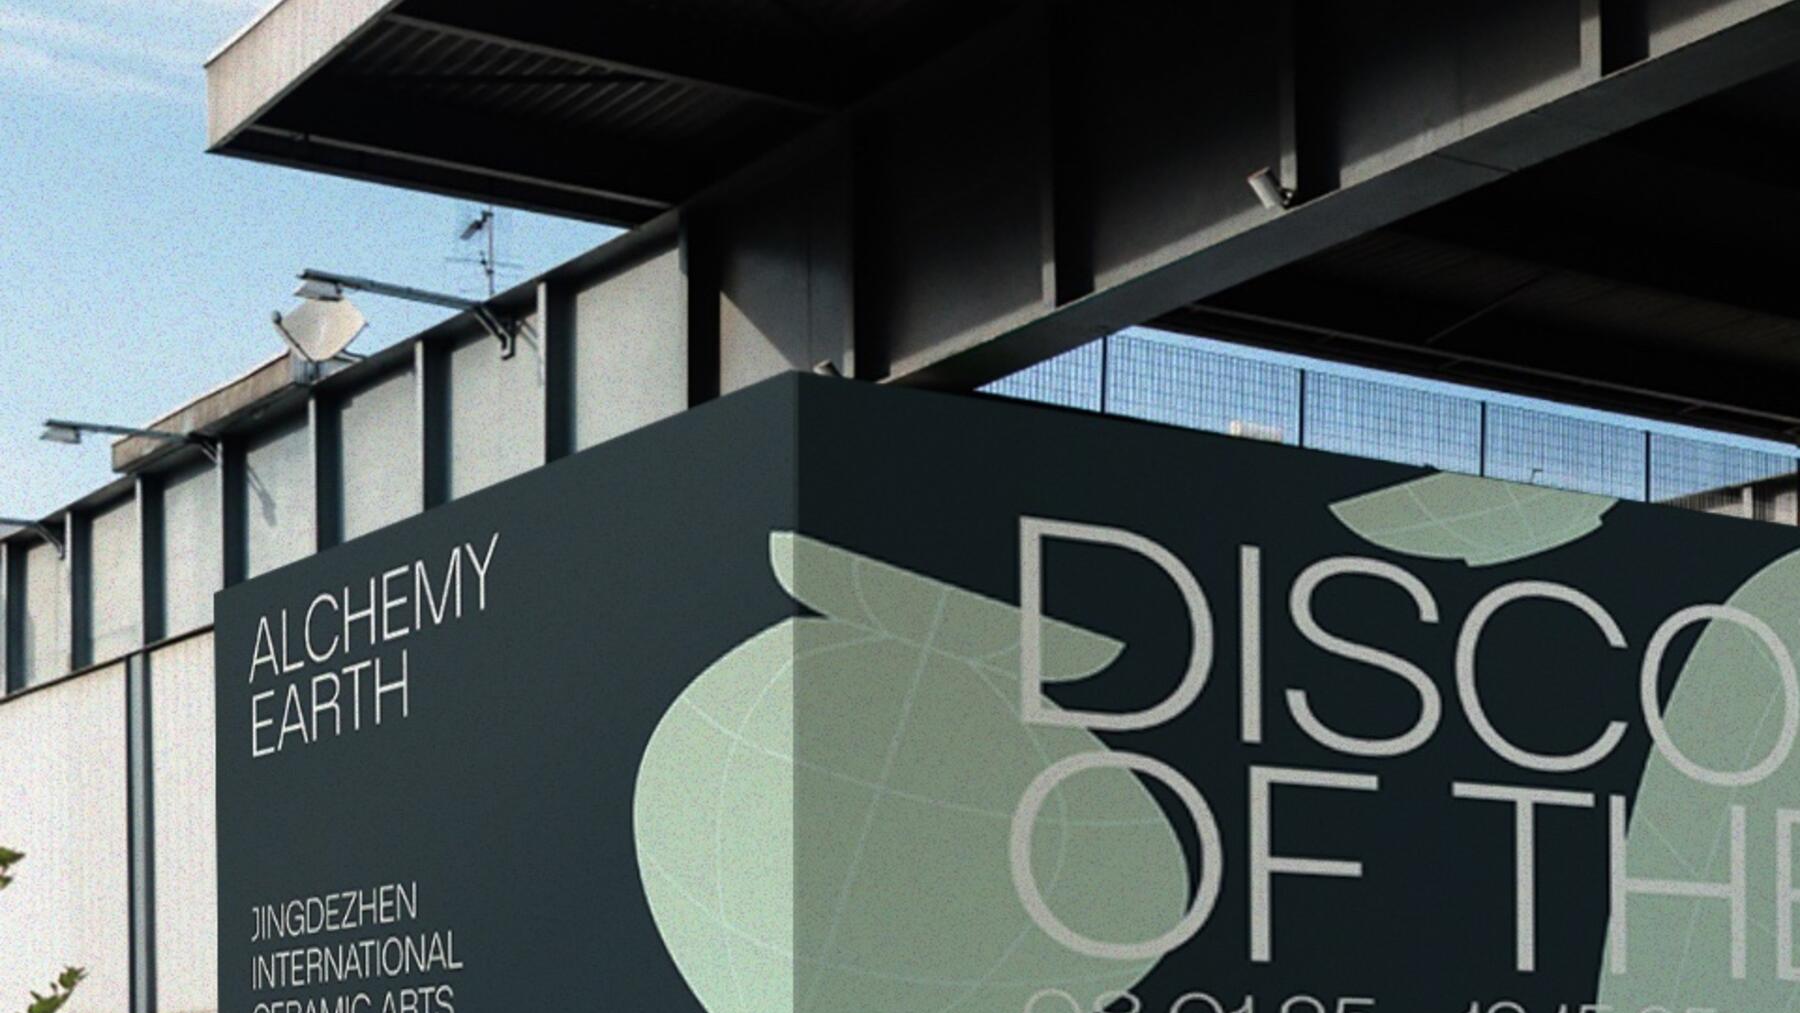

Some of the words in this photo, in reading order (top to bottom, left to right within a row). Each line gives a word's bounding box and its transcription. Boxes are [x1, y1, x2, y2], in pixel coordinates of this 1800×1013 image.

[249, 531, 499, 684] ALCHEMY
[251, 648, 409, 758] EARTH
[1009, 749, 1380, 962] OF
[250, 880, 418, 942] JINGDEZHEN
[251, 929, 464, 991] INTERNATIONAL
